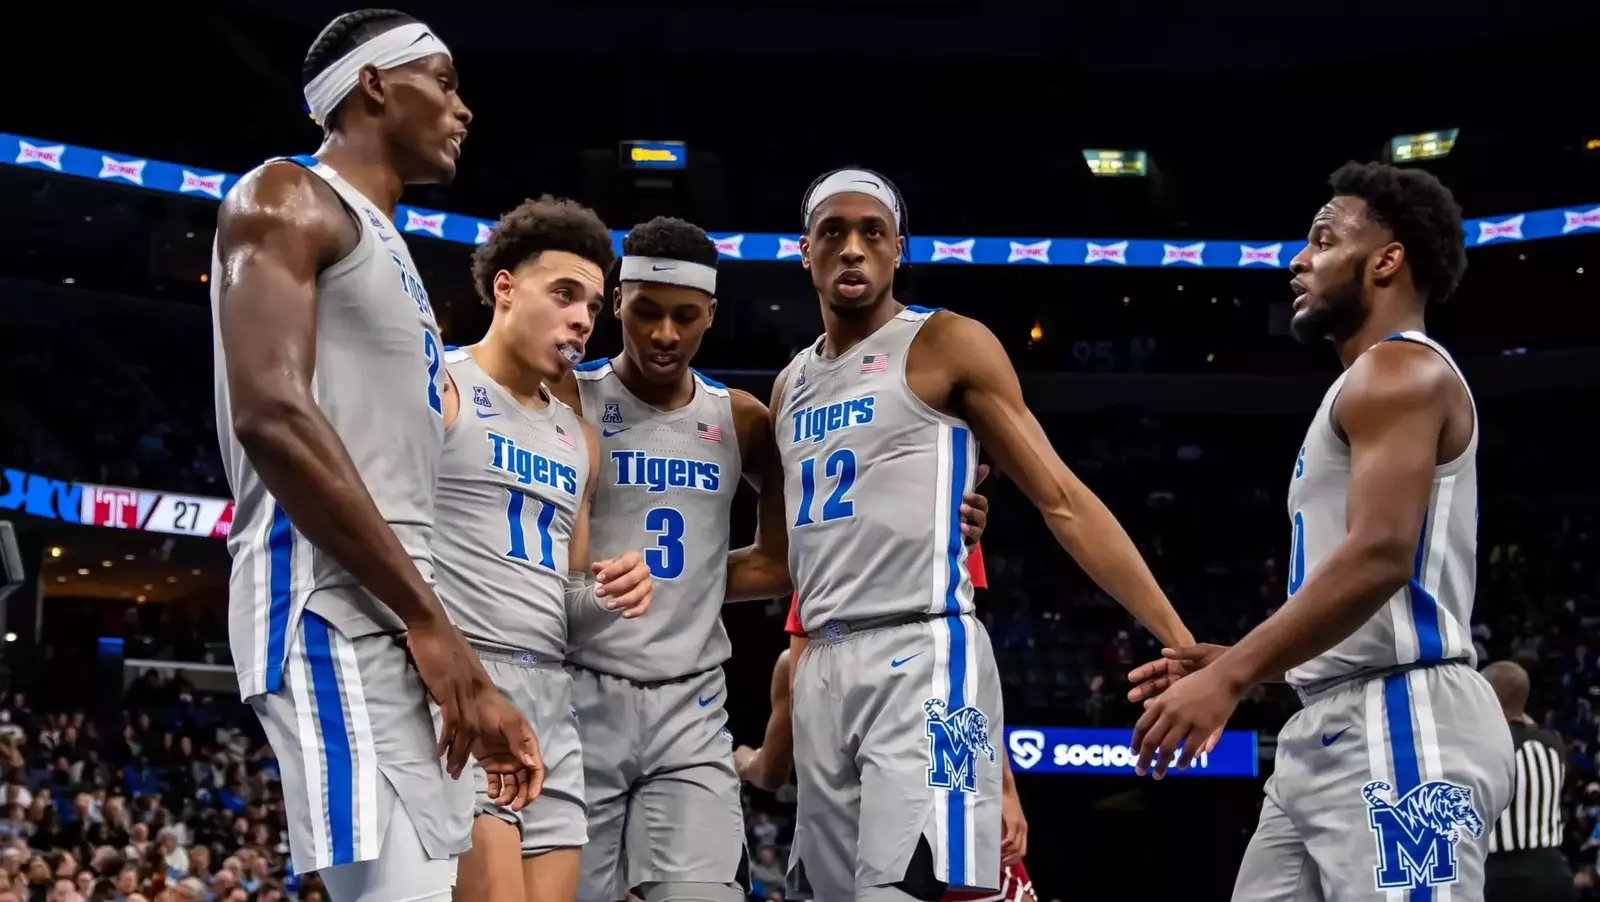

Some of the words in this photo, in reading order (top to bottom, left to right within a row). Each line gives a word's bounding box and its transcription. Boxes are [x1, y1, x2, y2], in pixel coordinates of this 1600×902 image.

[791, 395, 876, 444] Tigers
[487, 431, 578, 497] Tigers
[610, 449, 721, 494] Tigers
[792, 447, 858, 530] 12
[173, 500, 201, 532] 27
[504, 487, 557, 572] 11
[644, 506, 687, 581] 3
[1367, 804, 1460, 891] M
